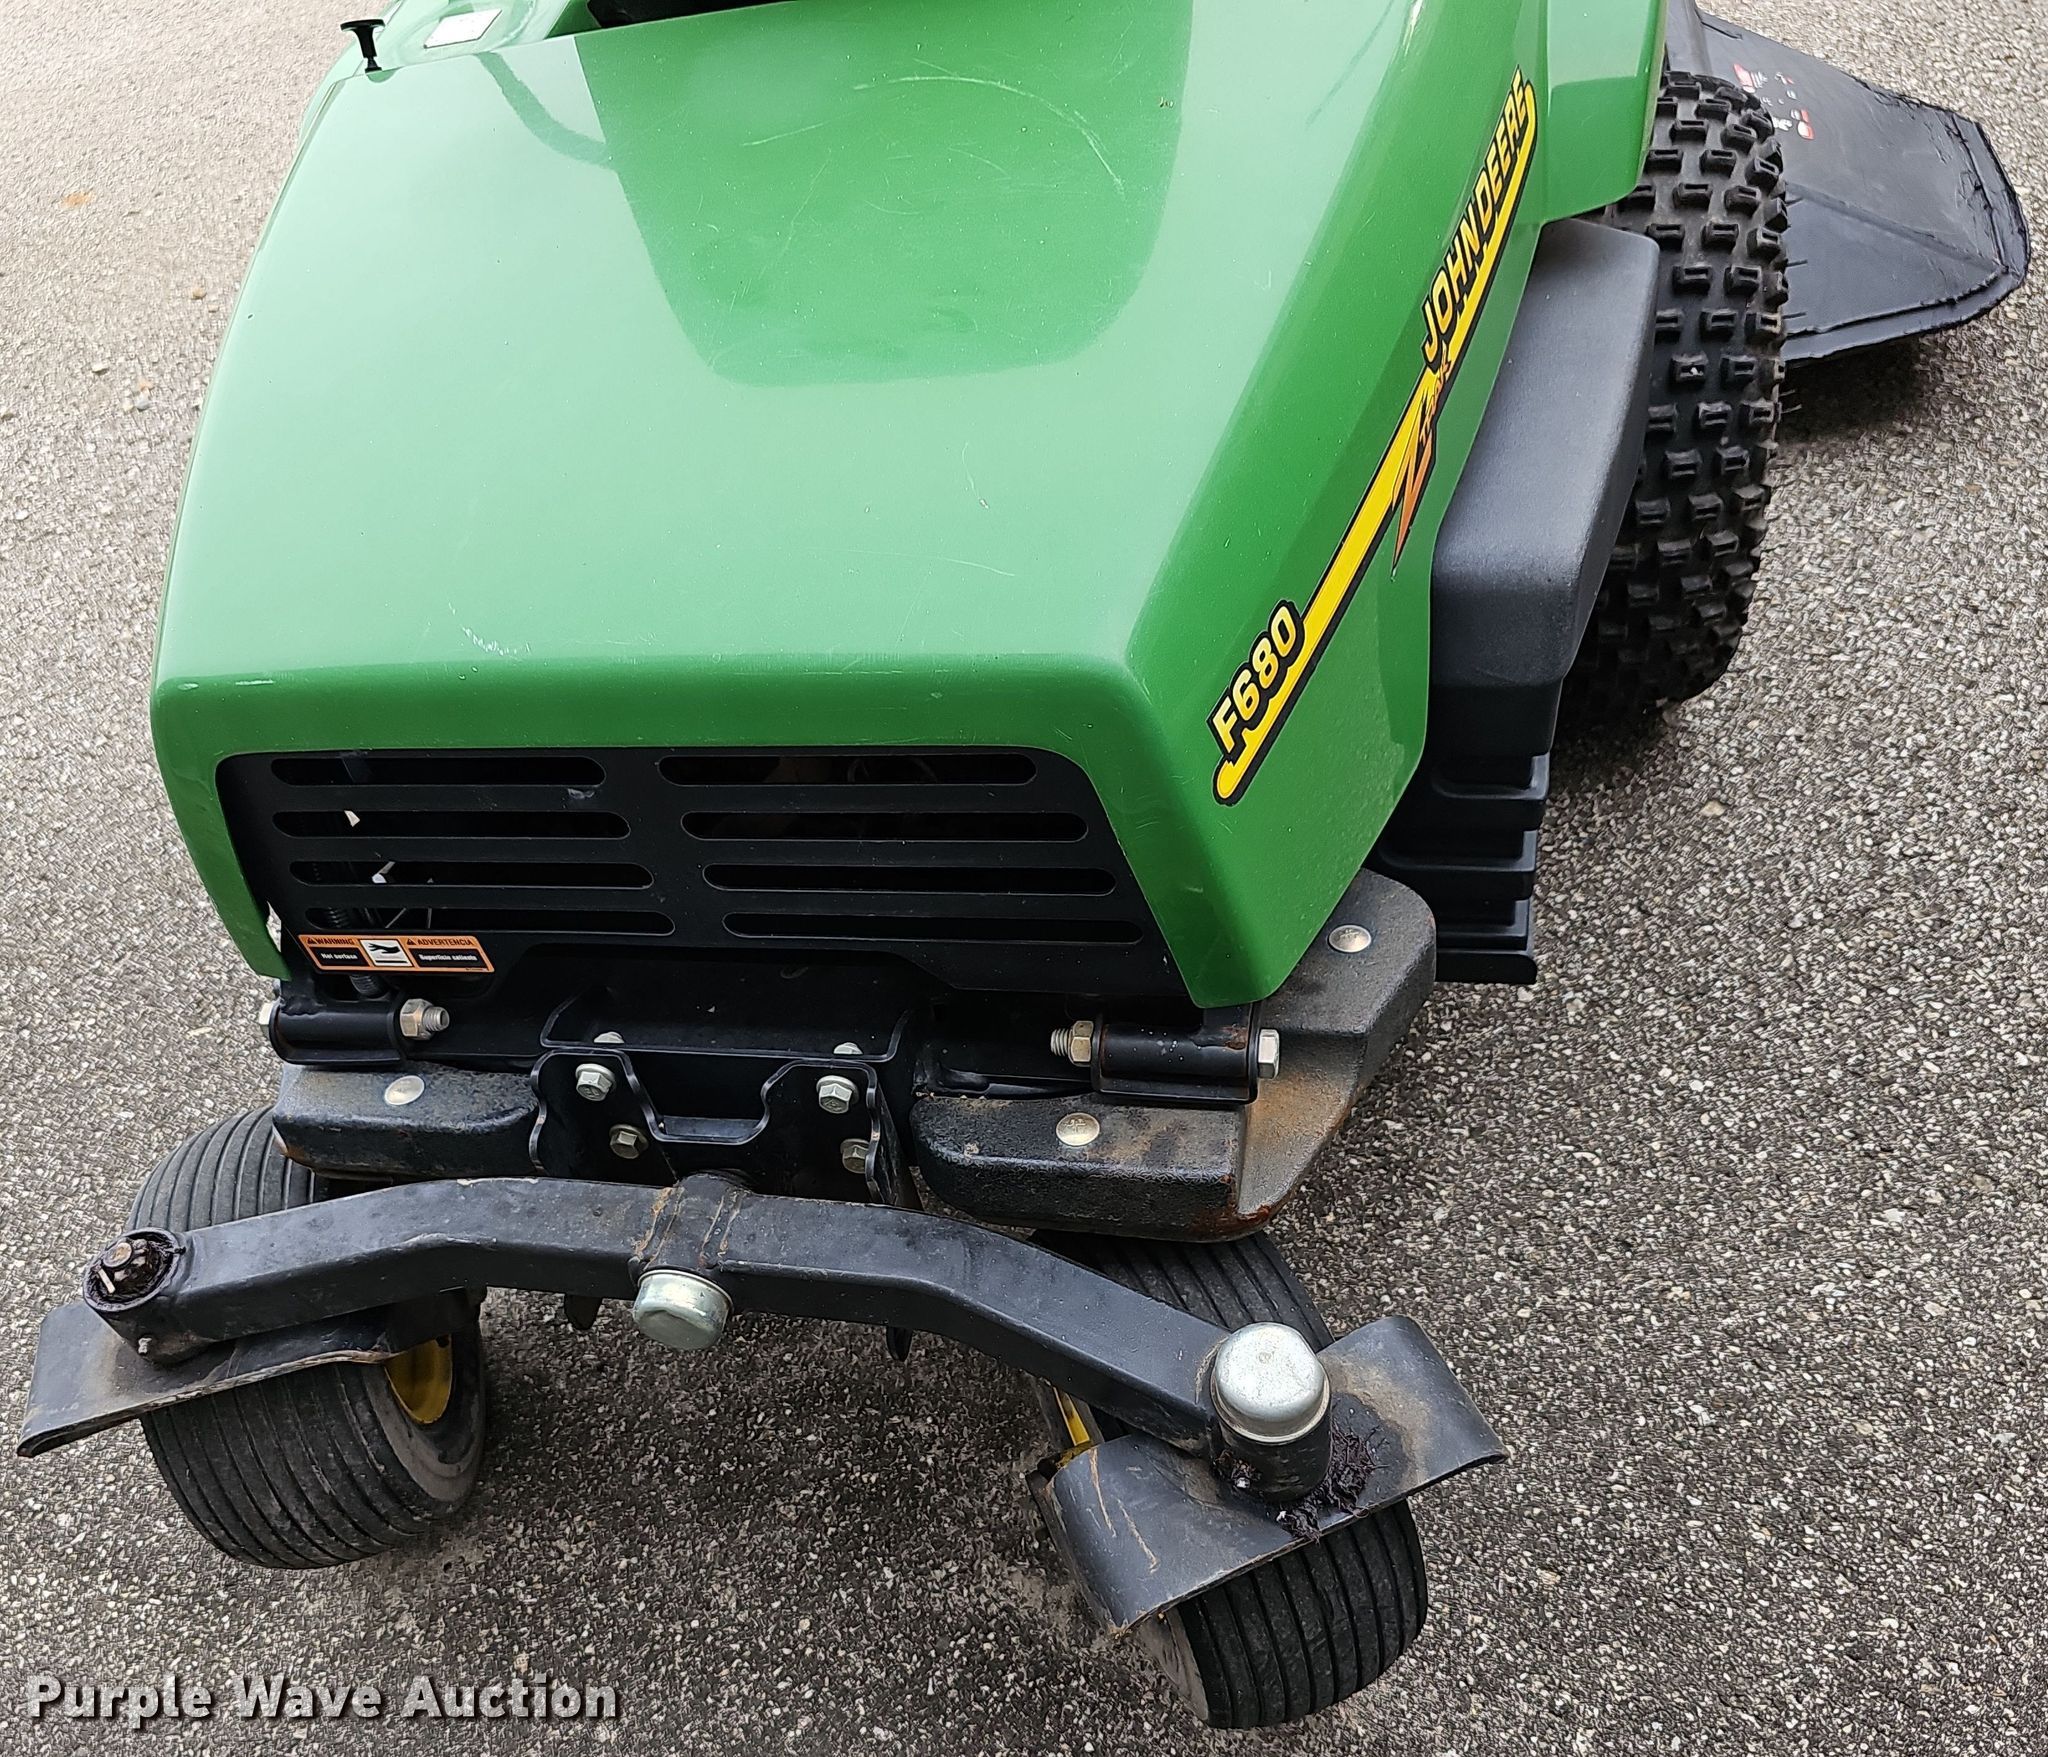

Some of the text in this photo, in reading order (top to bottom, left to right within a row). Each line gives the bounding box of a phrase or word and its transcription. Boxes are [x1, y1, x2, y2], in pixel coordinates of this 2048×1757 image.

[1424, 67, 1526, 362] JOHN DEERE
[1212, 606, 1297, 753] F680
[316, 937, 355, 945] WARNING
